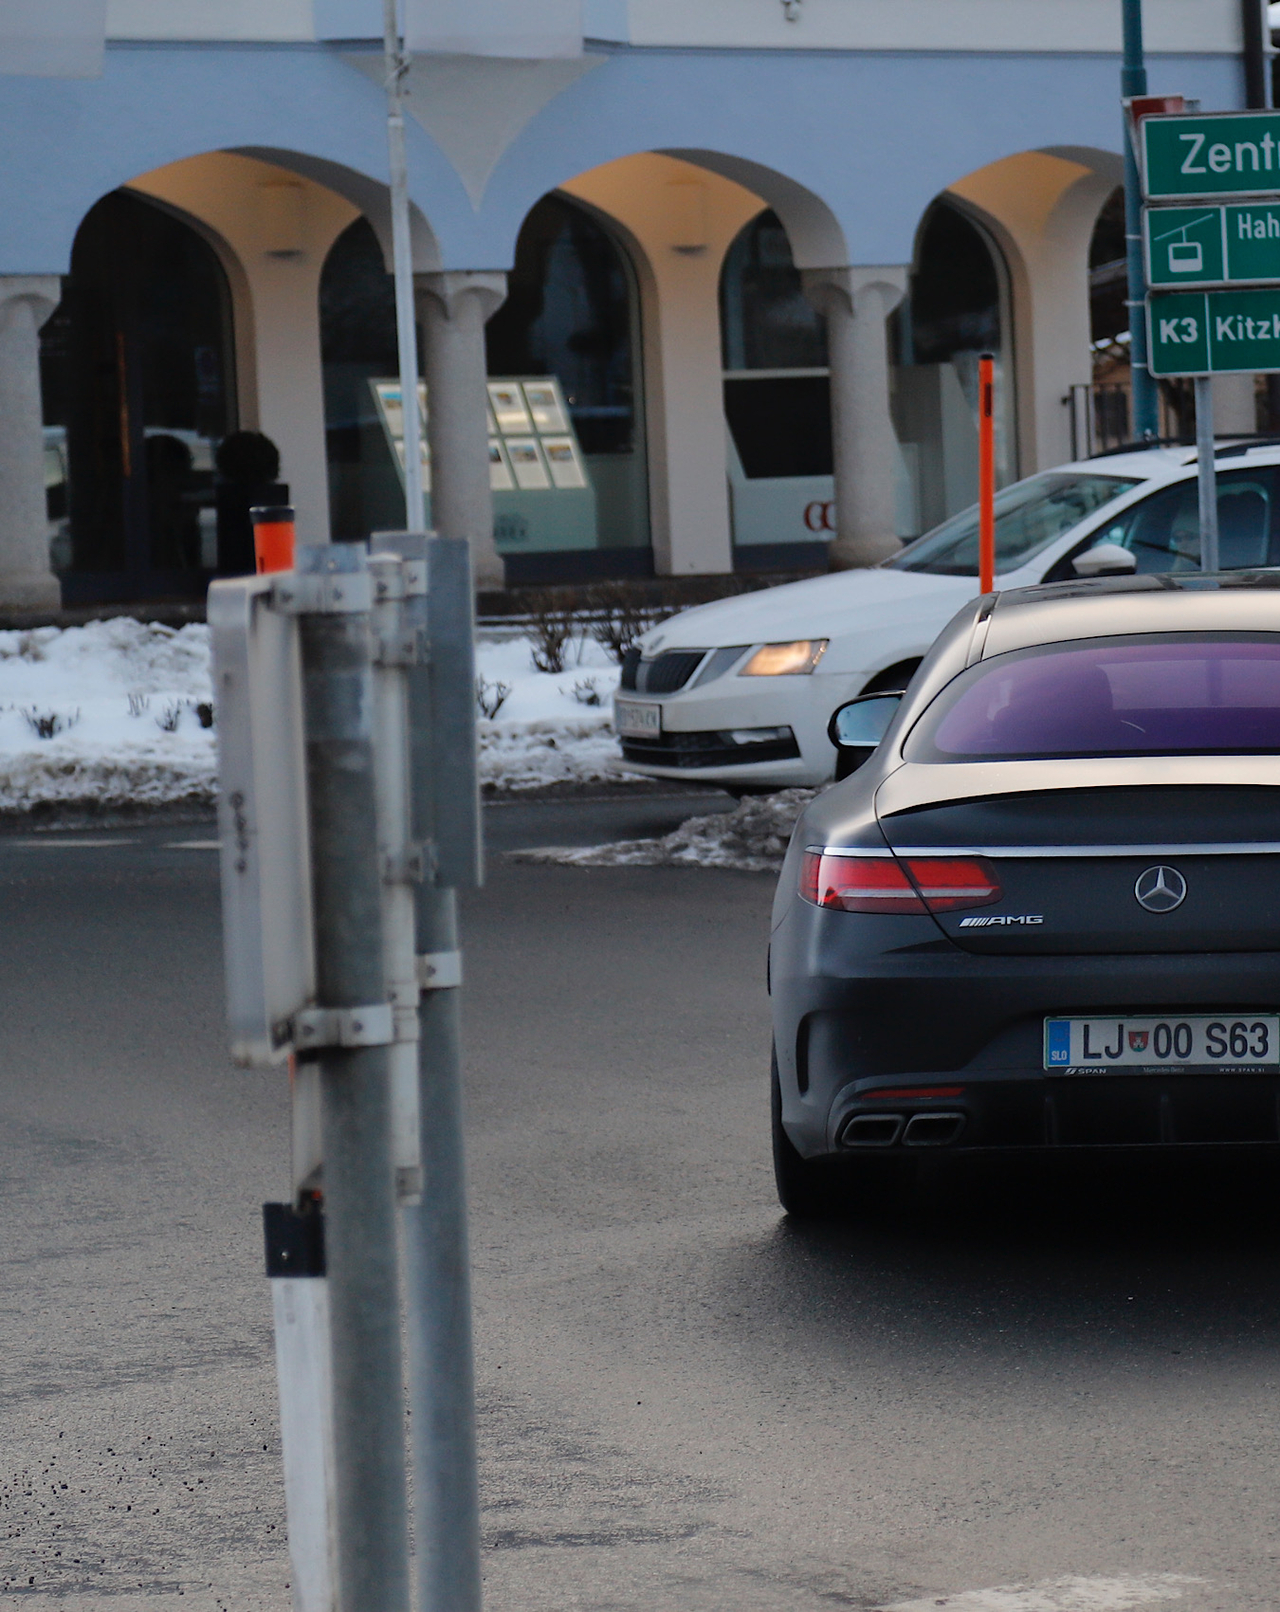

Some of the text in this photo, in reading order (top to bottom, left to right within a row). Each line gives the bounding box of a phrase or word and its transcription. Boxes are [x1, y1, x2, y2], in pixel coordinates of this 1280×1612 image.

[1159, 316, 1199, 344] K3
[988, 914, 1044, 926] AMG
[1083, 1023, 1124, 1059] LJ
[1205, 1021, 1269, 1058] S63
[1051, 1050, 1068, 1061] SLO
[1077, 1067, 1107, 1075] SPAN
